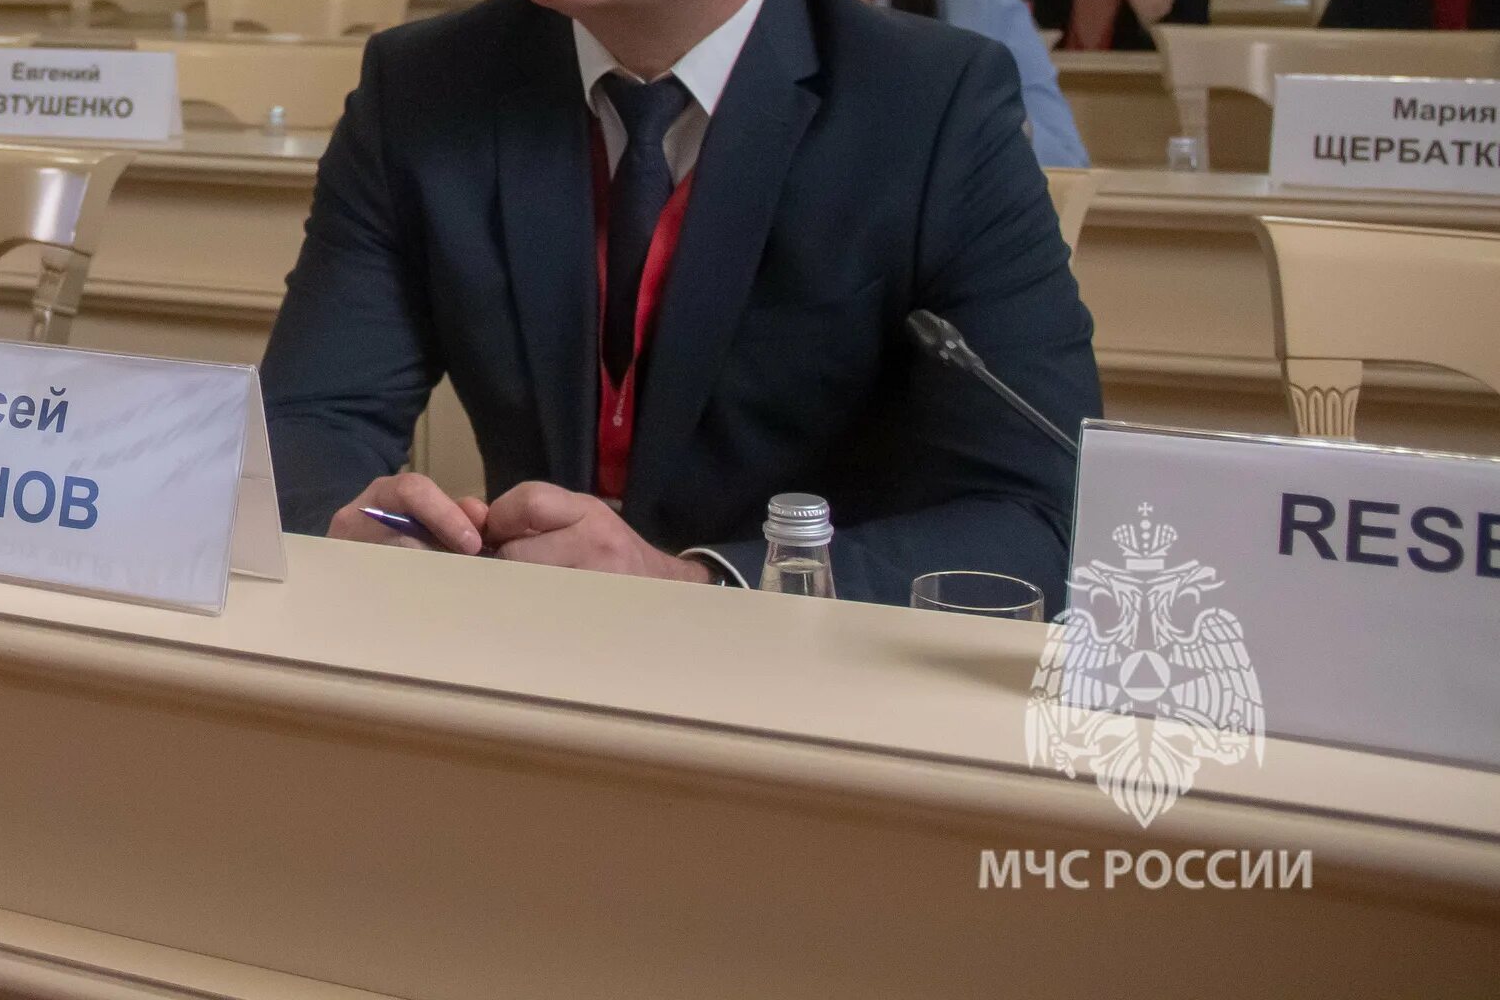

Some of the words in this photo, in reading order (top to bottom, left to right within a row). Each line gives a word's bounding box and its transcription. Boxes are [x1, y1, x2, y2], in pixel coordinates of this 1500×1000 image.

[11, 62, 101, 82] Евгений
[1392, 97, 1497, 126] Мария
[1313, 133, 1500, 168] ЩЕРБАТК
